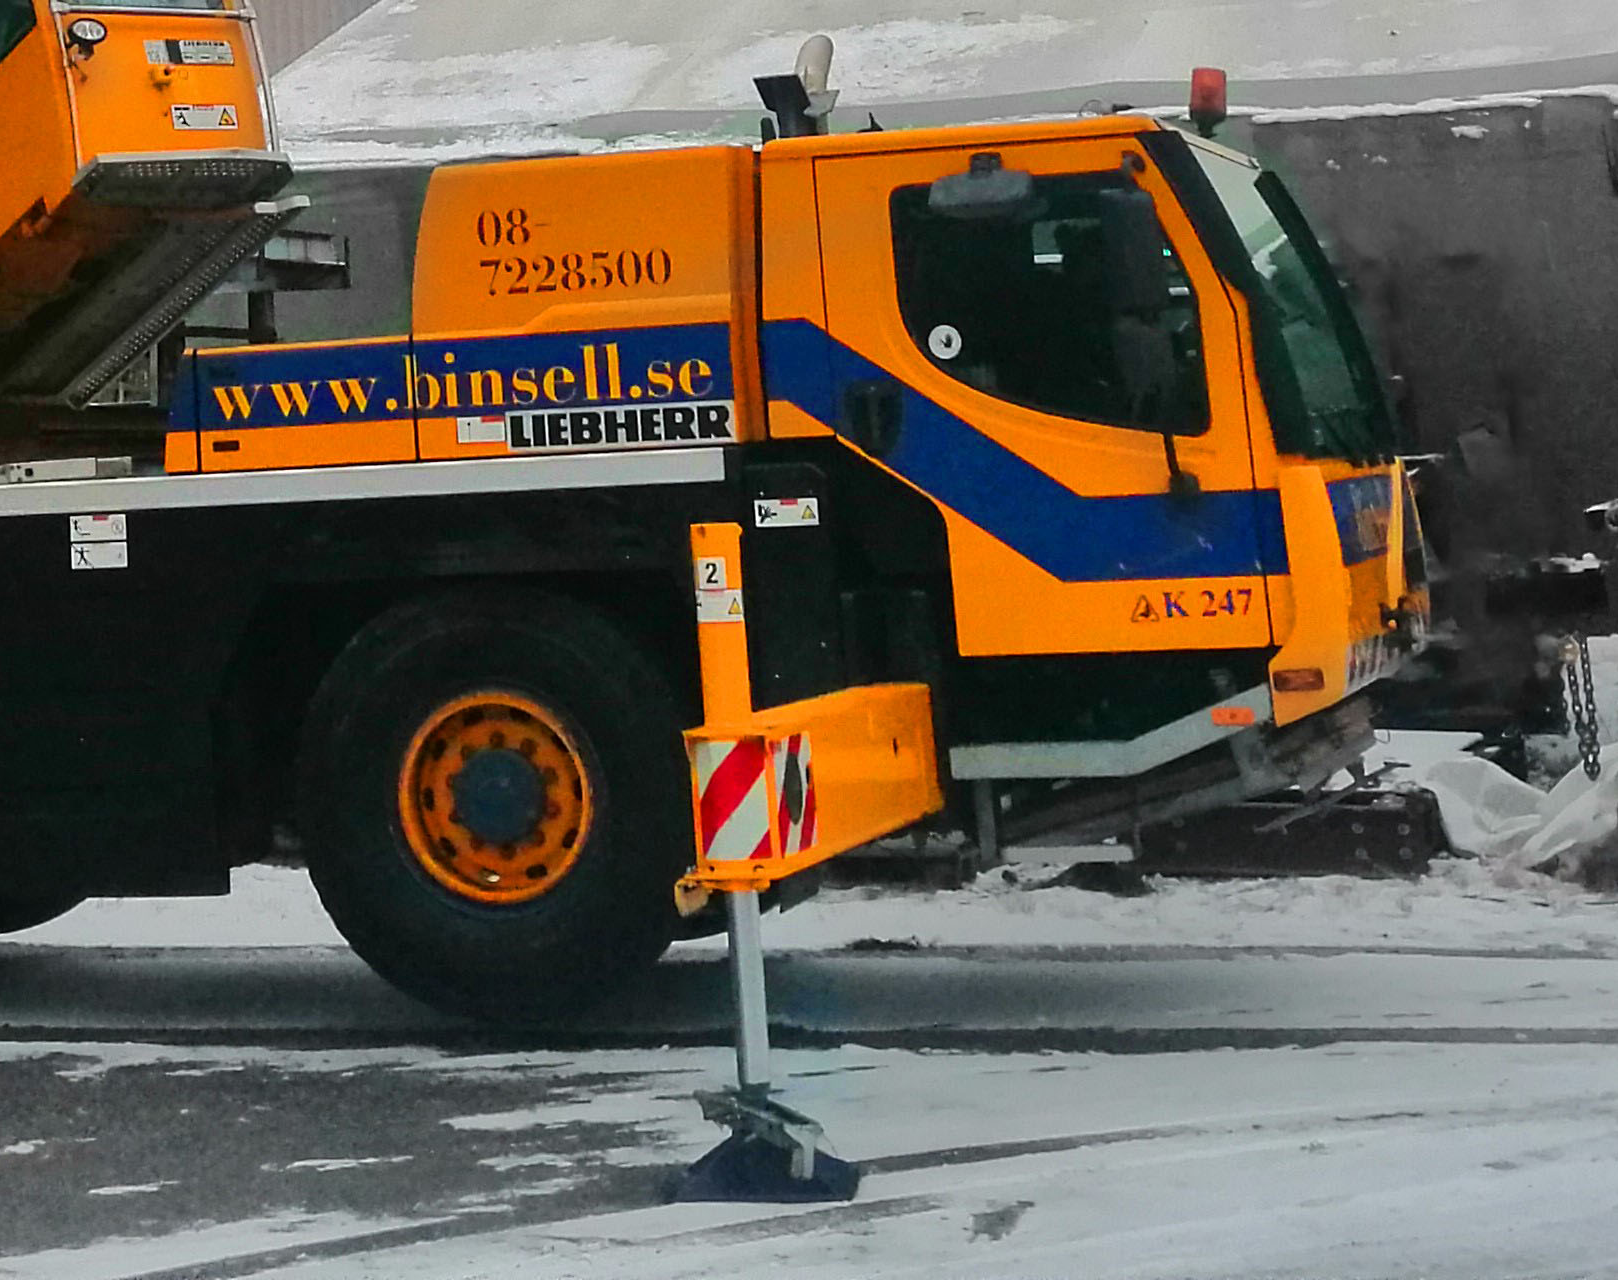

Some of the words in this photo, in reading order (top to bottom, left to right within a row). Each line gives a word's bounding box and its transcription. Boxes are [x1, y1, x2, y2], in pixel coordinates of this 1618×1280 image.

[480, 248, 672, 296] 7228500
[213, 343, 713, 420] www.binsell.se
[509, 404, 732, 448] LIEBHERR
[705, 562, 719, 584] 2
[1201, 589, 1252, 616] 247
